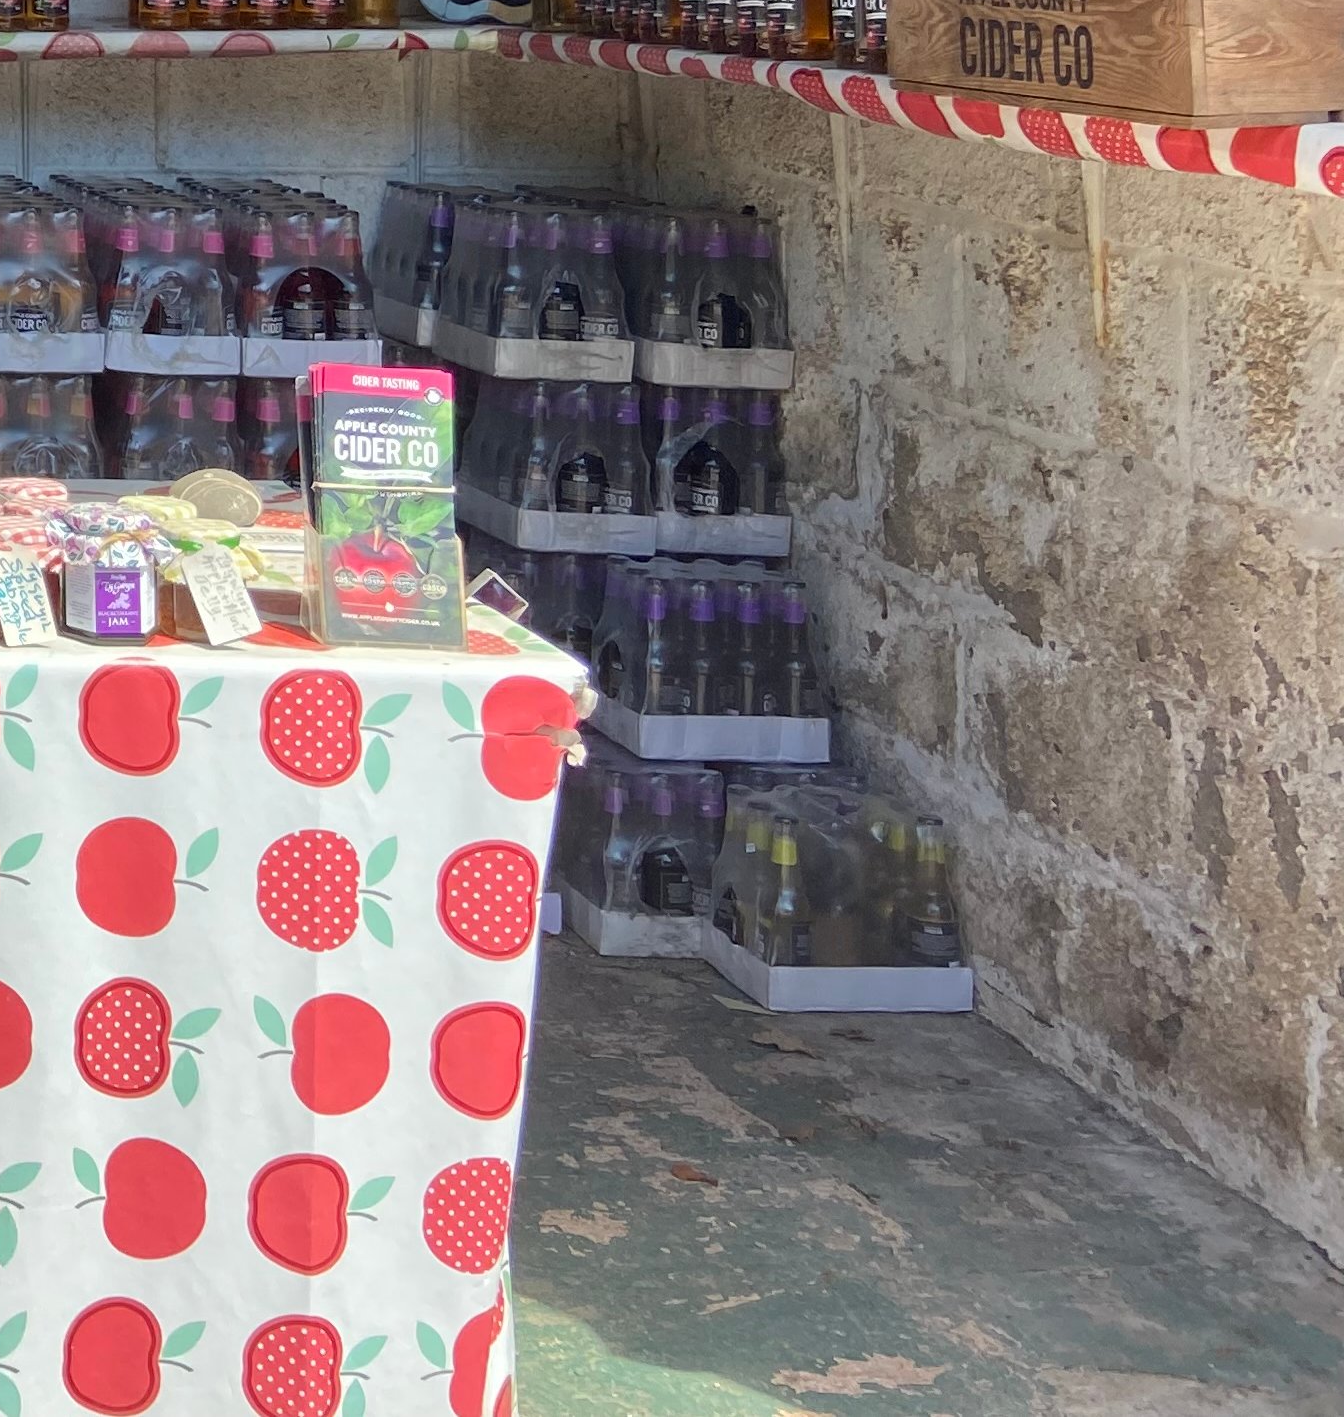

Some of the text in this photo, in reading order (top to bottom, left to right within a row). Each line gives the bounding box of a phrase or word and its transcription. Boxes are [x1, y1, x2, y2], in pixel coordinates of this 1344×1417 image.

[959, 17, 1094, 90] CIDER CO
[352, 375, 420, 391] CIDER TASTING
[334, 419, 437, 438] APPLE COUNTY
[334, 434, 439, 468] CIDER CO
[108, 616, 129, 627] JAM
